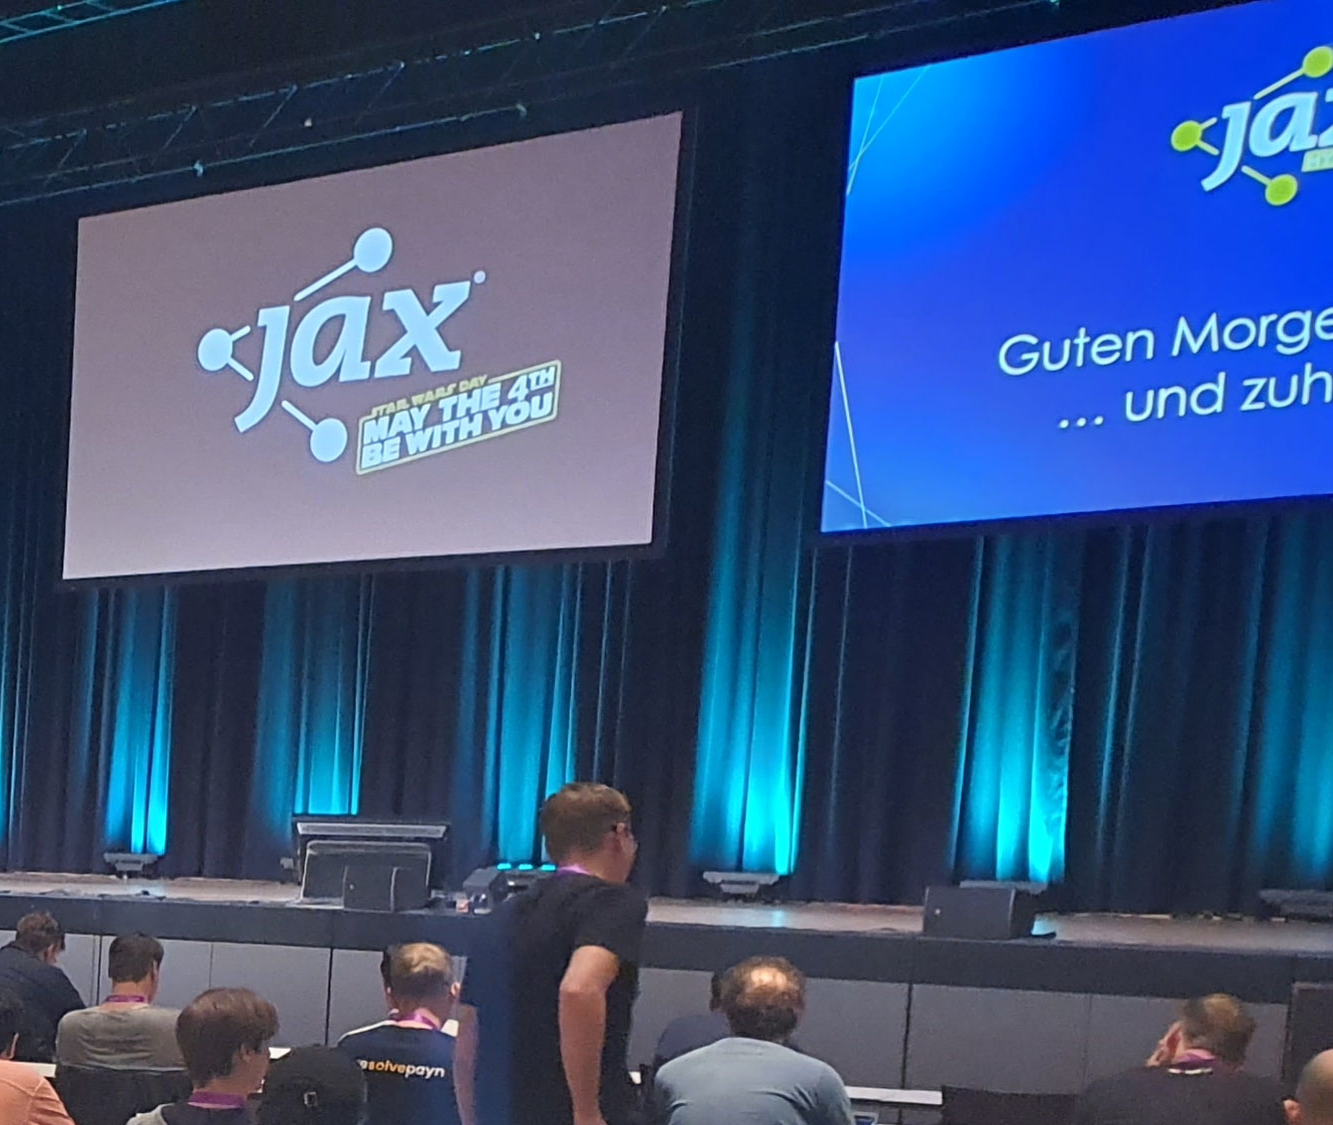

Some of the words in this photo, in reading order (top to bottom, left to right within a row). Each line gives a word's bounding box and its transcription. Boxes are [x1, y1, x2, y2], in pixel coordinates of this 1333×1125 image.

[1202, 88, 1333, 191] ja
[233, 281, 472, 433] jax
[998, 327, 1155, 376] Guten
[362, 437, 401, 469] BE
[406, 418, 483, 456] WITH
[488, 393, 553, 431] YOU
[364, 405, 431, 445] MAY
[438, 383, 501, 422] THE
[508, 366, 555, 402] 4TH
[369, 398, 410, 418] STAR
[411, 383, 456, 407] WARS
[459, 374, 488, 393] DAY
[1058, 415, 1104, 429] ...
[1125, 371, 1226, 423] und
[1240, 362, 1333, 411] zuh
[357, 1059, 445, 1079] esolvepayn
